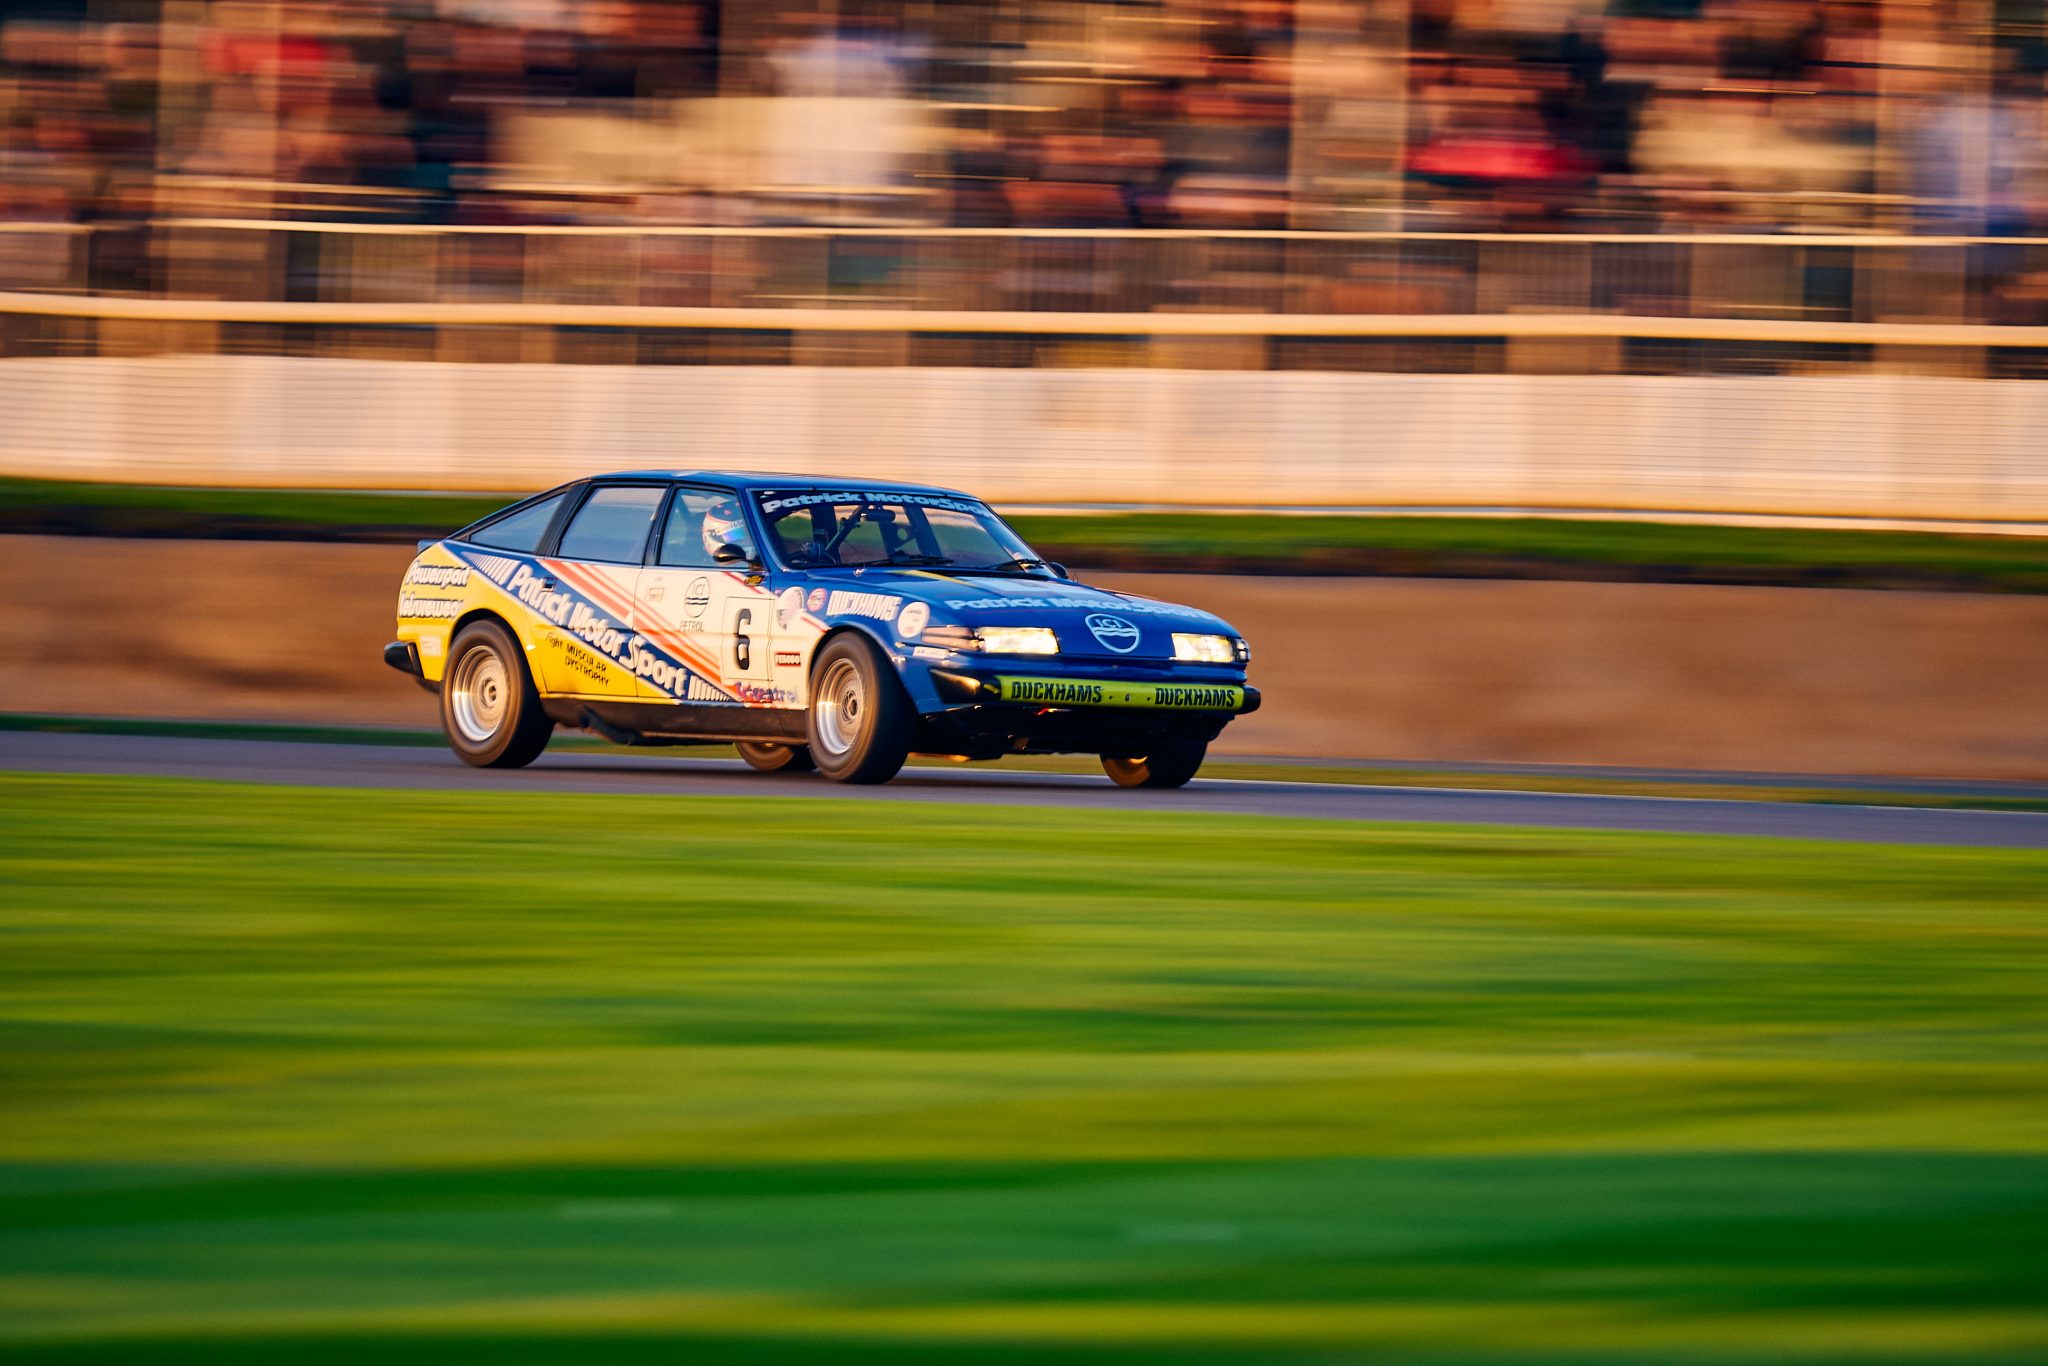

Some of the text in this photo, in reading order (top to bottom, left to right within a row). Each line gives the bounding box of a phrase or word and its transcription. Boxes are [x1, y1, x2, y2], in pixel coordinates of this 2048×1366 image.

[762, 492, 862, 514] Patrick
[507, 563, 575, 624] Patrick
[692, 584, 705, 596] ICI
[827, 590, 903, 621] DUCKHAMS
[944, 597, 1047, 610] Patrick
[680, 621, 704, 632] PETROL
[1095, 619, 1121, 628] ICI
[735, 608, 751, 670] 6
[566, 643, 607, 672] MUSCULAR
[775, 654, 801, 665] FERODO
[565, 656, 609, 688] DYSTROPHY
[1011, 681, 1102, 703] DUCKHAMS
[1155, 687, 1235, 707] DUCKHAMS
